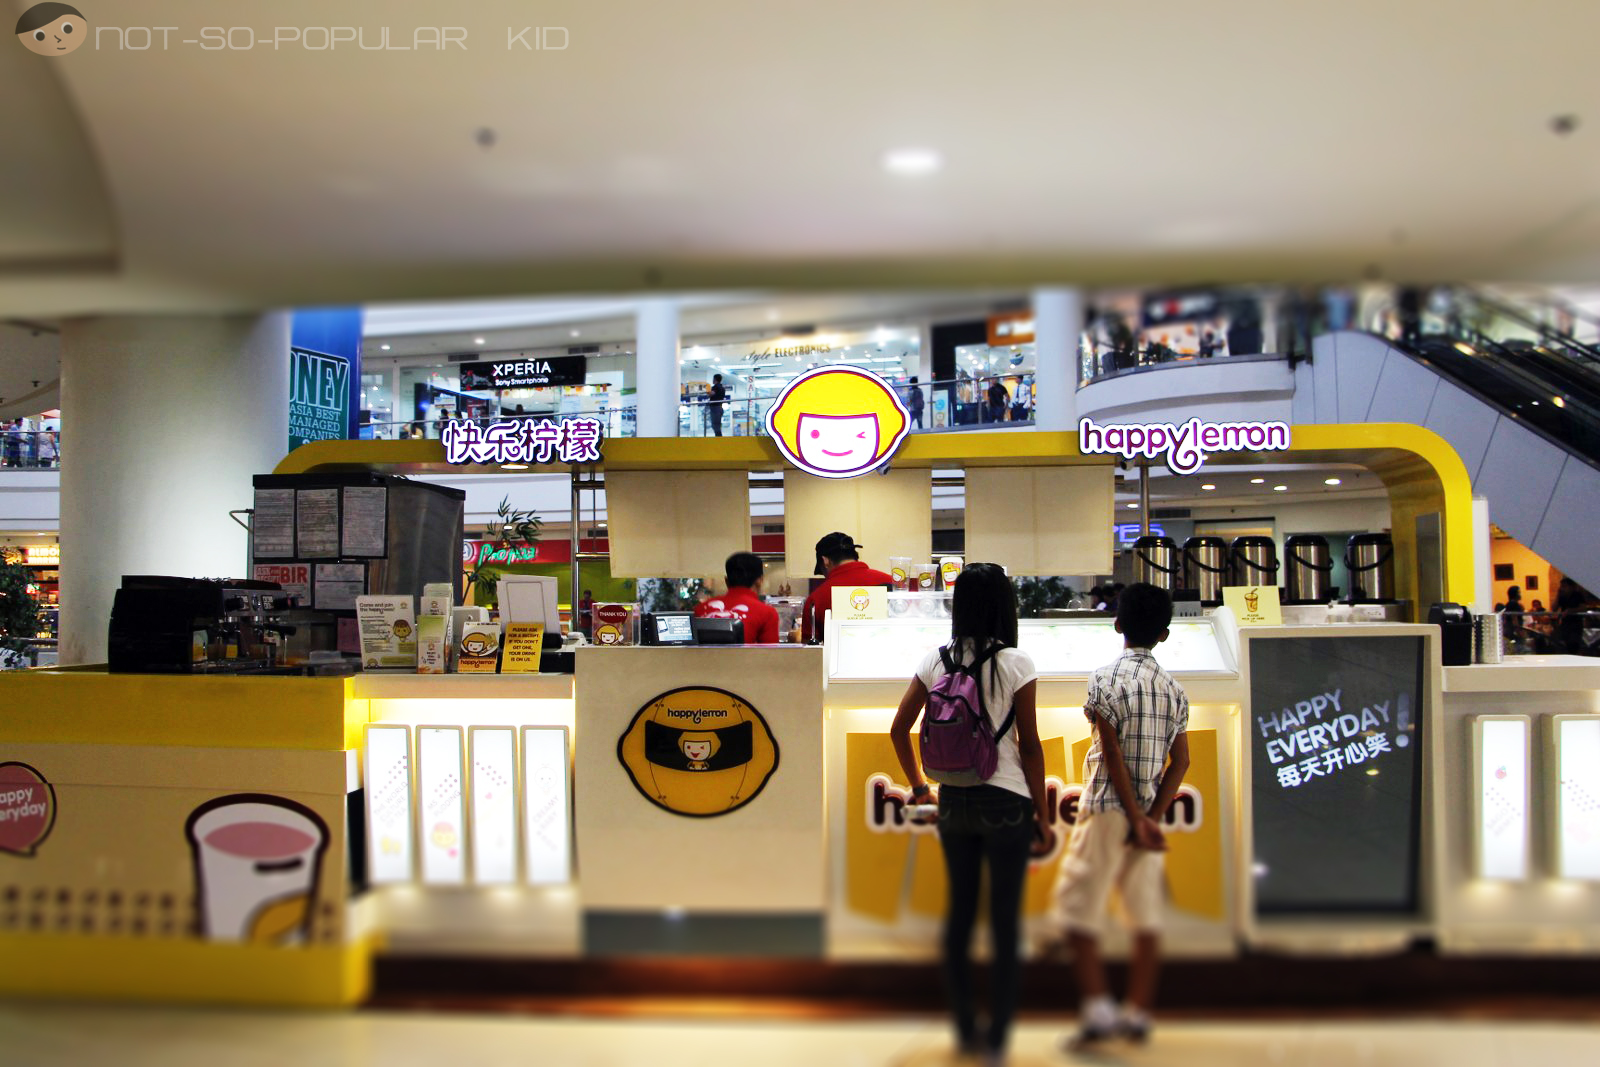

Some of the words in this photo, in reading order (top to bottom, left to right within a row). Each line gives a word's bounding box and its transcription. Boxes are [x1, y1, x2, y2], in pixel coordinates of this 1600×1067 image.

[775, 344, 831, 358] ELECTRONICS
[493, 361, 551, 376] XPERIA
[495, 379, 510, 387] Sony
[511, 377, 549, 385] Smartphone
[290, 404, 313, 417] ASIA
[316, 410, 340, 421] BEST
[288, 425, 340, 441] OMPANIES
[442, 418, 602, 464] 快乐柠檬
[1079, 417, 1291, 475] happylemon
[281, 566, 308, 584] BIR
[667, 707, 728, 725] happylemon
[1257, 688, 1342, 738] HAPPY
[1276, 732, 1392, 788] 每天开心笑
[0, 788, 33, 806] appy
[0, 802, 46, 822] eryday
